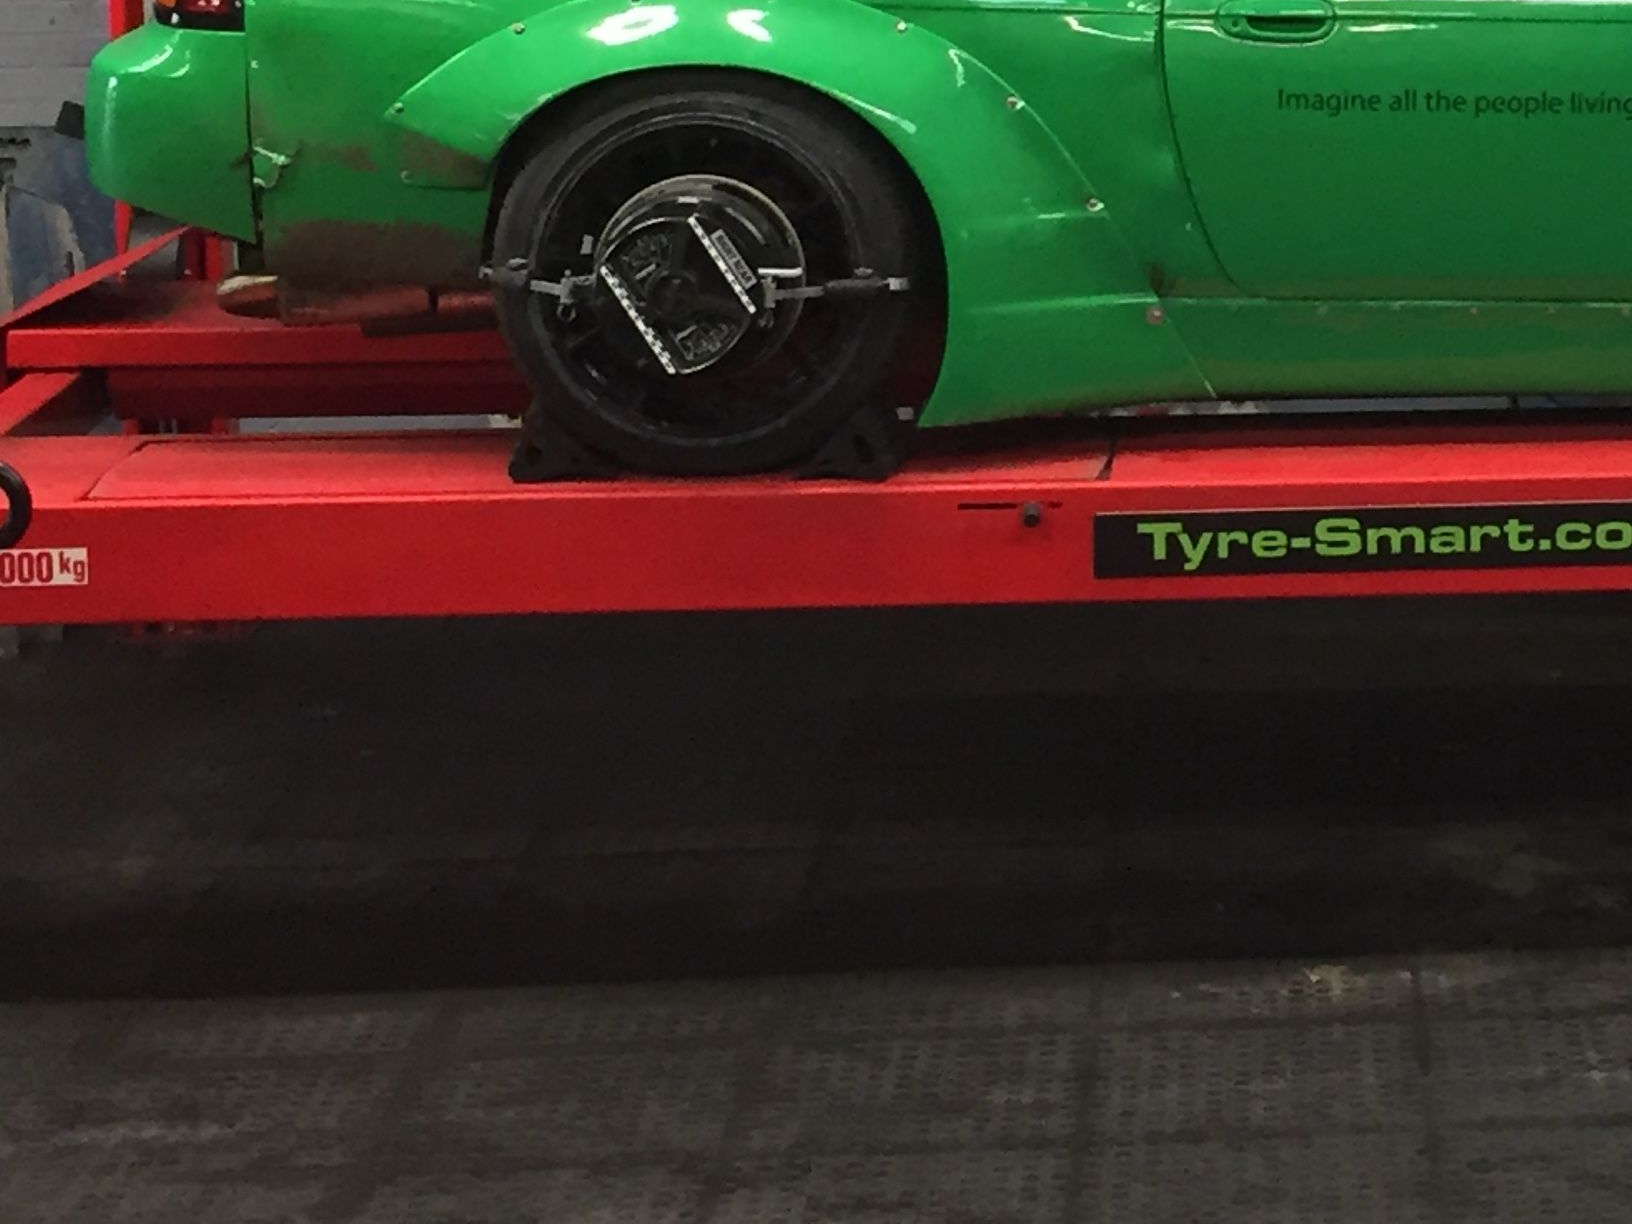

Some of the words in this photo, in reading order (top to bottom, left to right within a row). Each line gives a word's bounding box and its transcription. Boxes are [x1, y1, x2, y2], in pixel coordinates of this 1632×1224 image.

[1277, 88, 1382, 117] Imagine
[1388, 89, 1418, 112] all
[1424, 90, 1467, 112] the
[1473, 91, 1564, 119] people
[58, 550, 86, 583] kg
